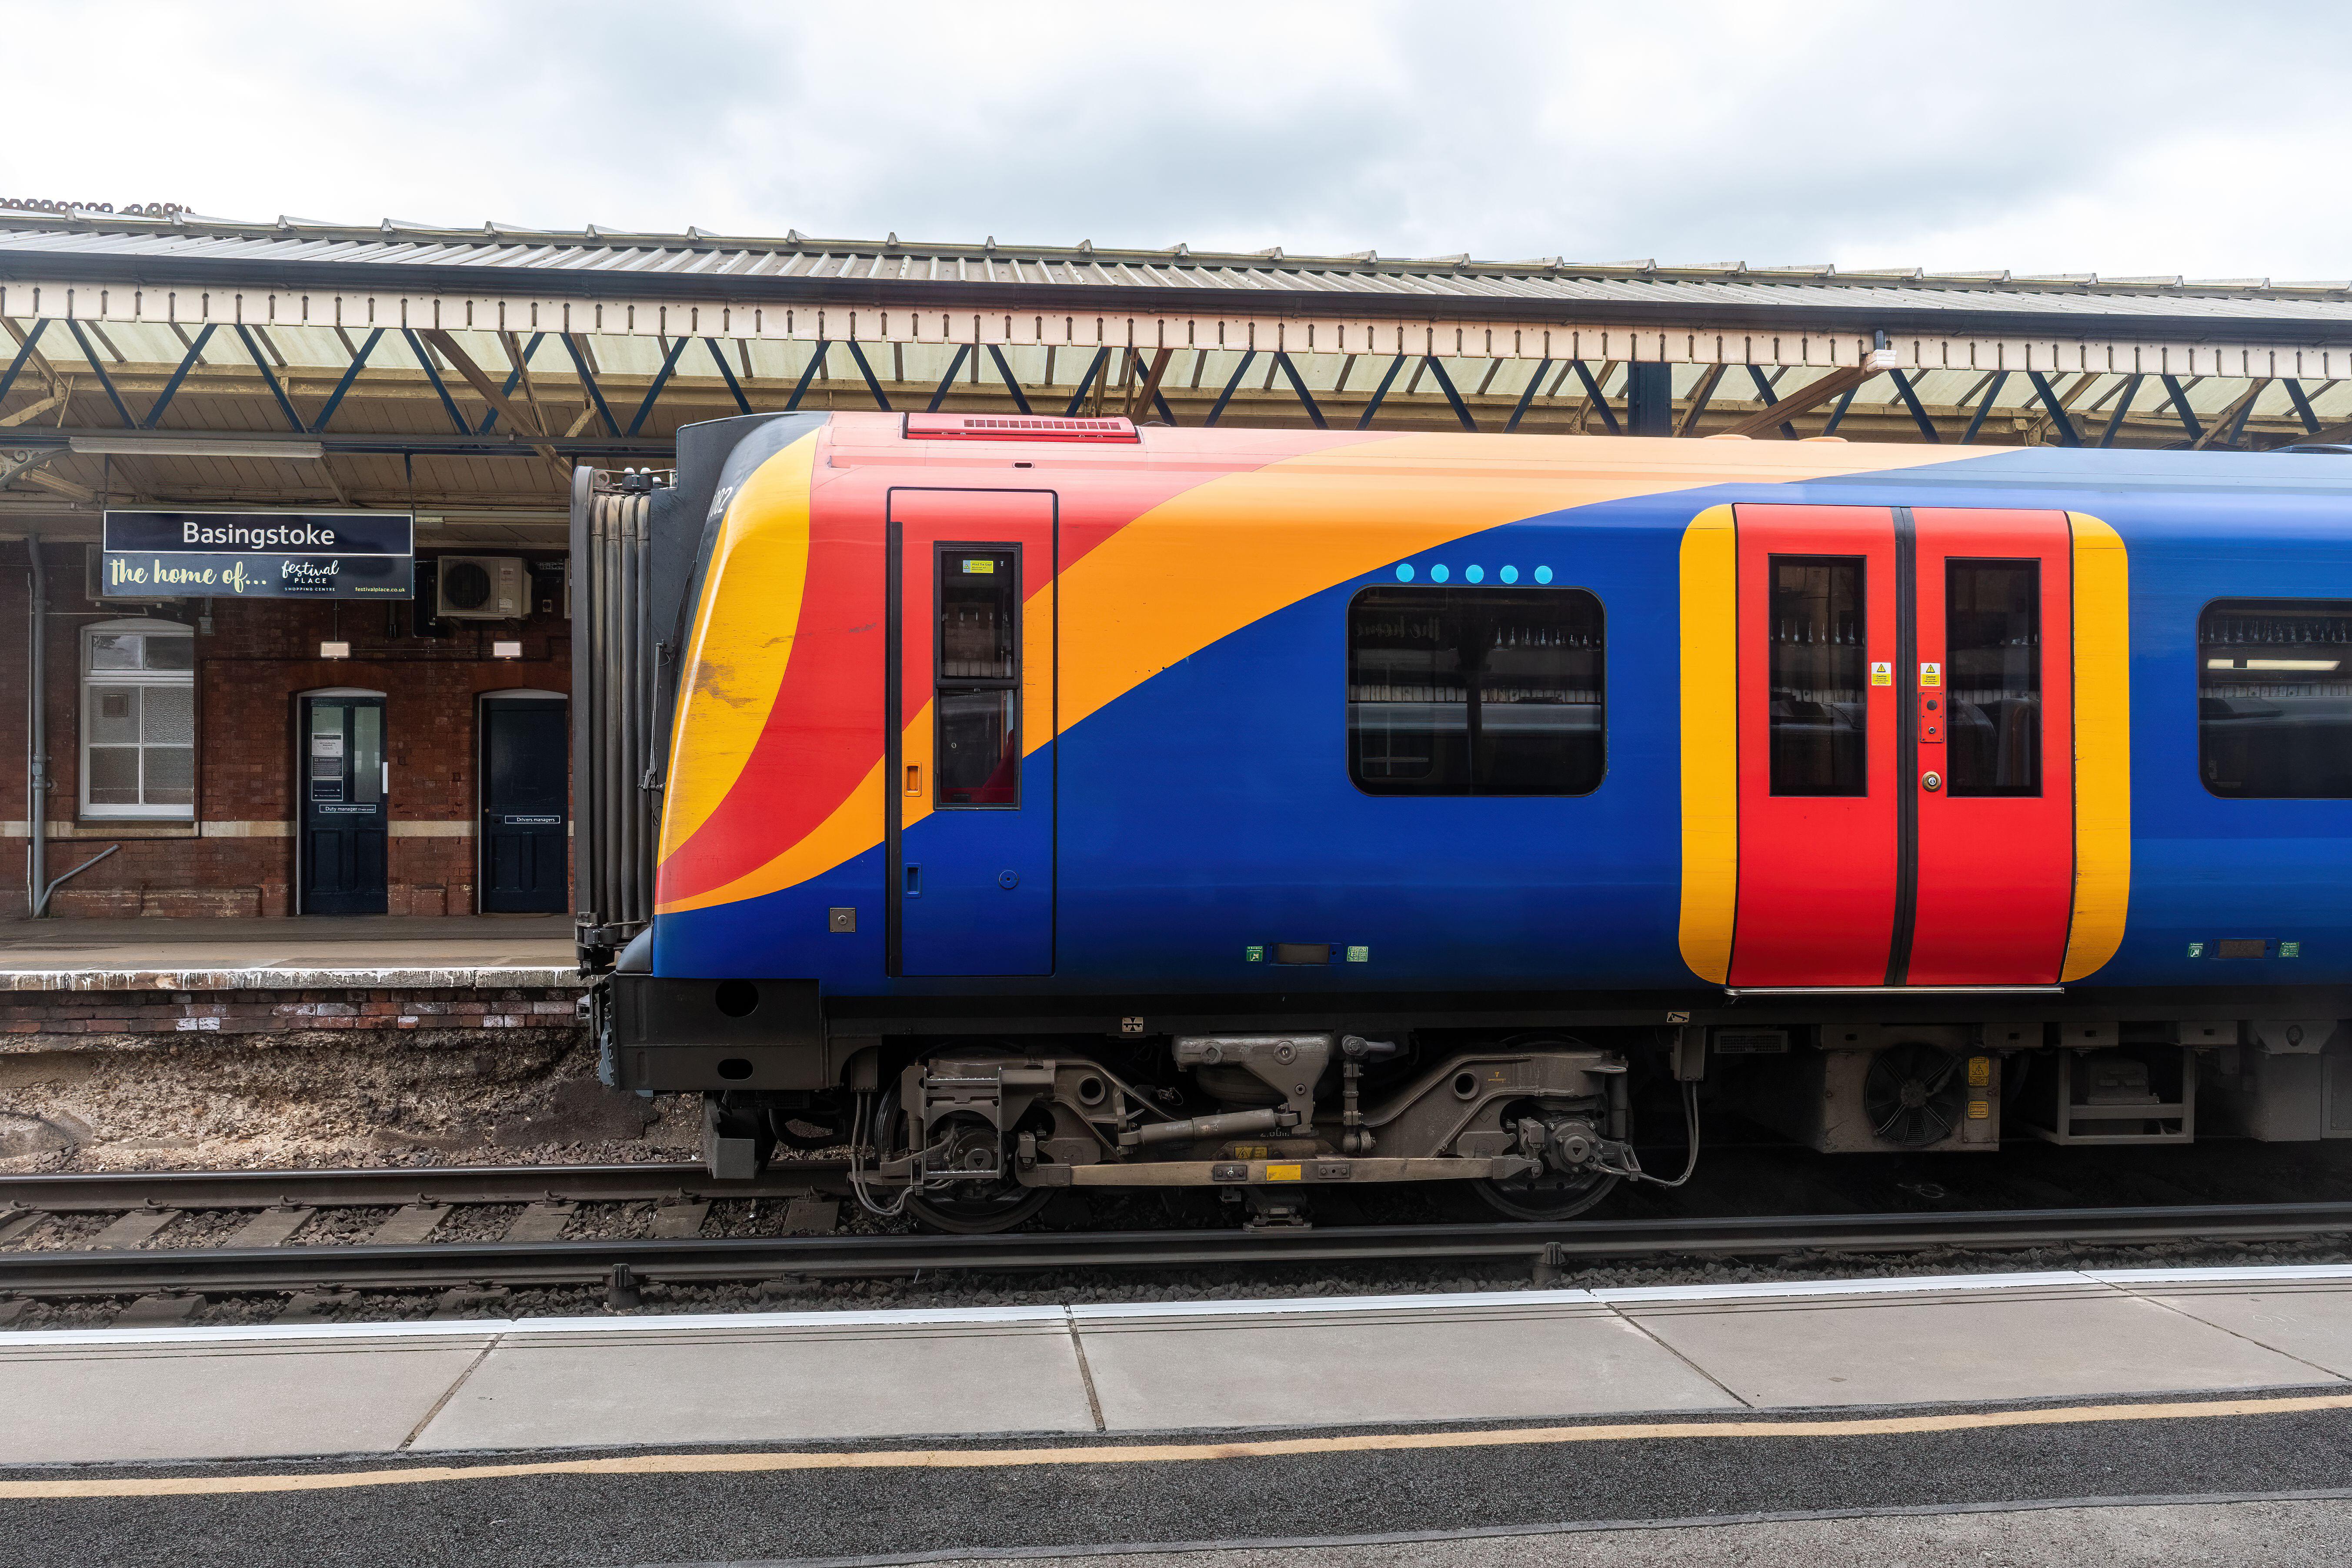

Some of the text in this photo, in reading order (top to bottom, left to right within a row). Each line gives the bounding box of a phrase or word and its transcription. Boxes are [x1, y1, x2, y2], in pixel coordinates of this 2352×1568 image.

[183, 522, 334, 549] Basingstoke
[154, 559, 217, 584] home
[222, 561, 267, 593] of...
[281, 560, 339, 578] festival
